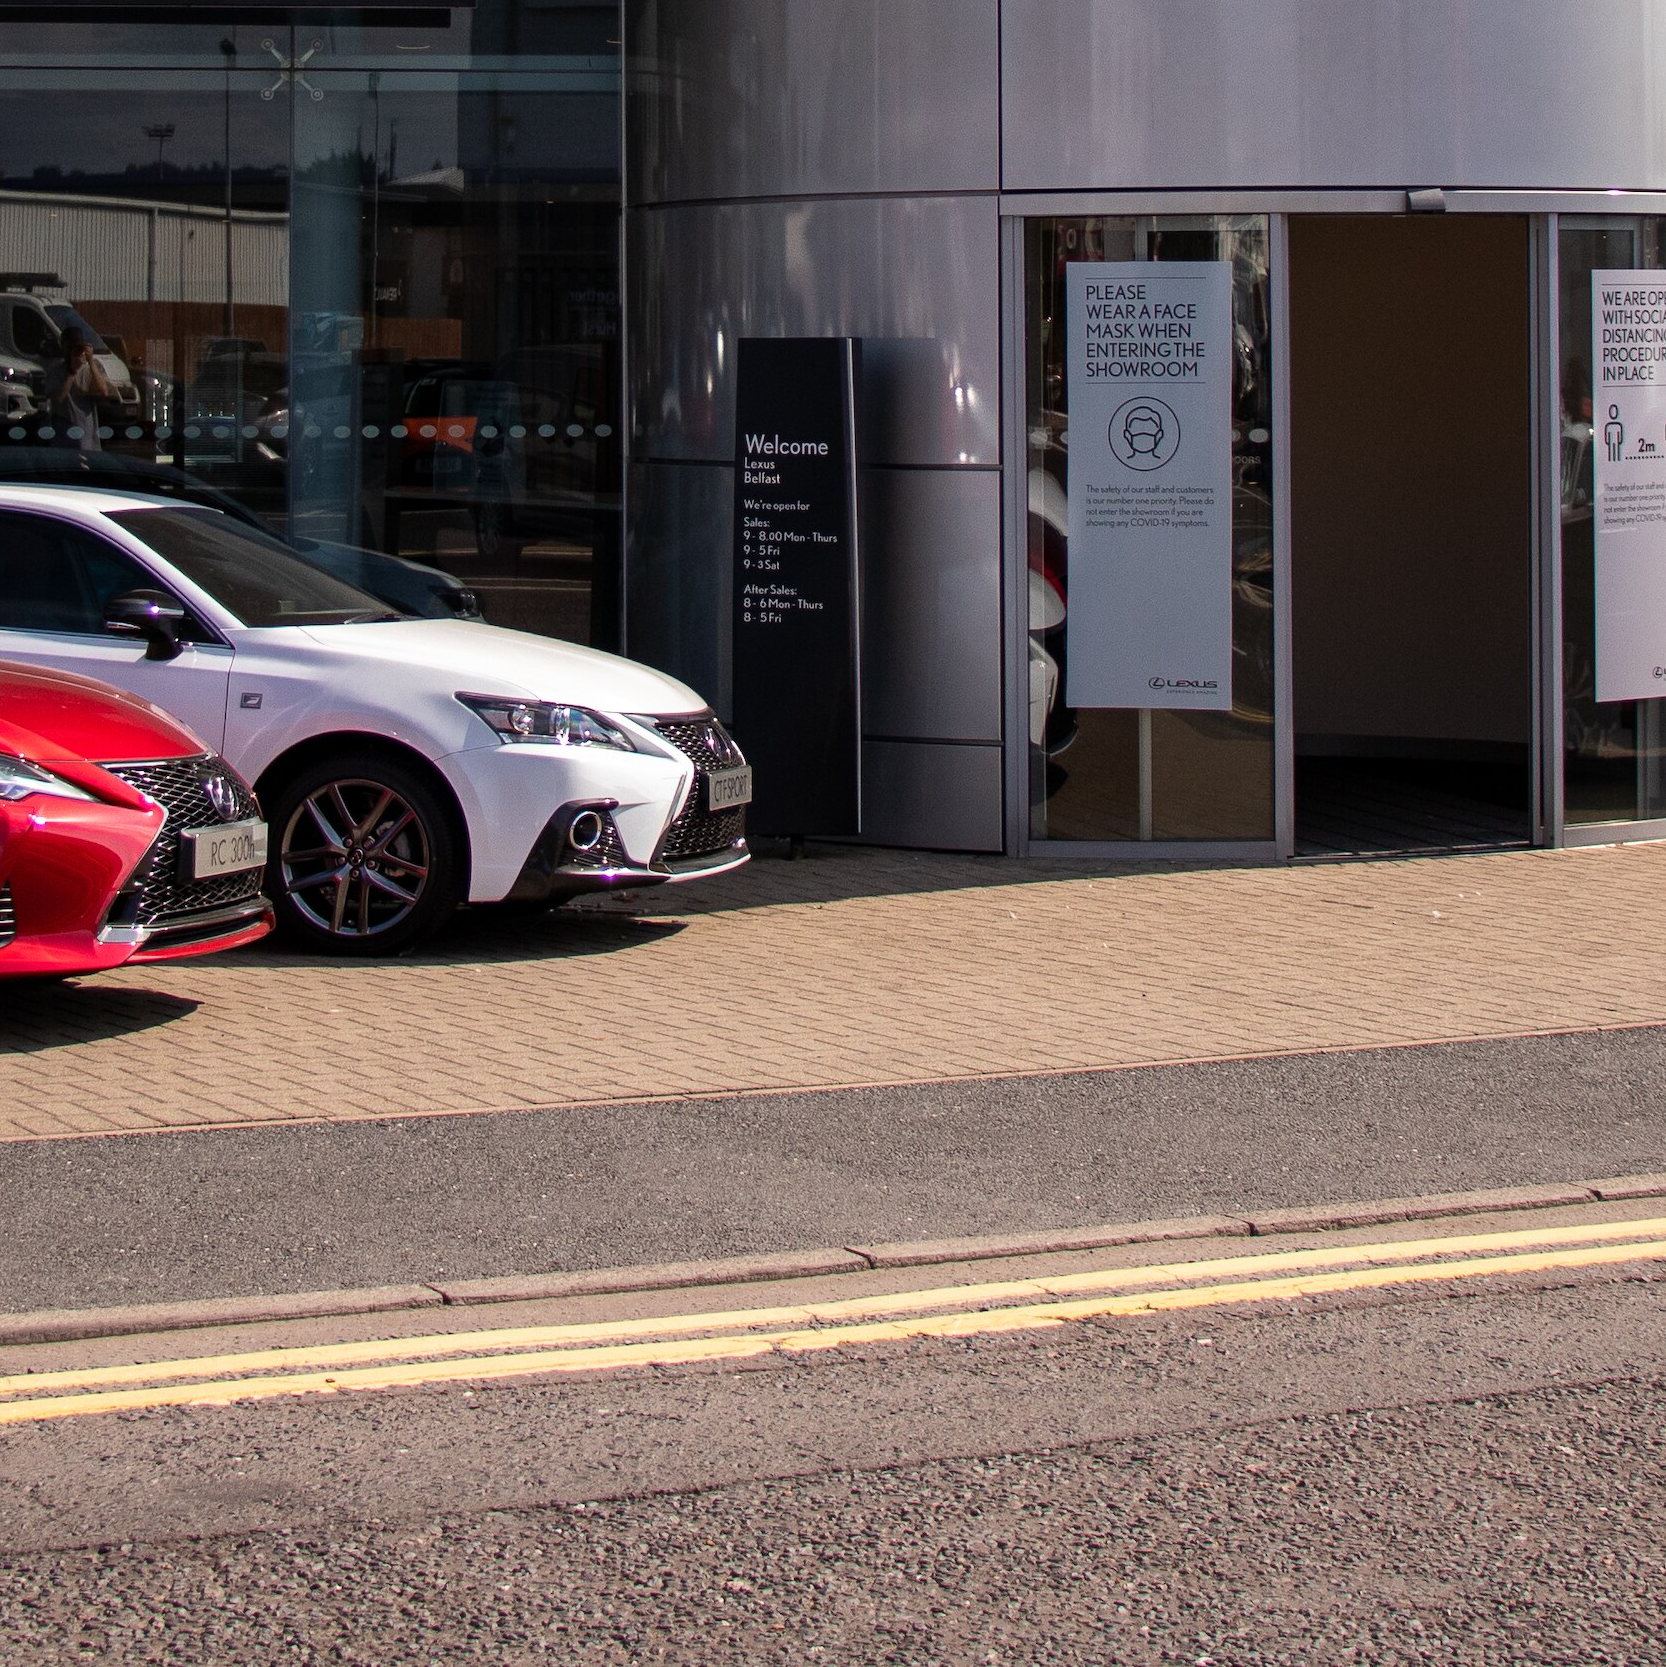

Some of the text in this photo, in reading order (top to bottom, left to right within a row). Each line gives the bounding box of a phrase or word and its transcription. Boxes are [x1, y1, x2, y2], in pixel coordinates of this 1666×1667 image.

[1086, 285, 1146, 300] PLEASE
[1602, 292, 1621, 305] WE
[1624, 292, 1646, 305] ARE
[1086, 304, 1196, 319] WEAR A FACE
[1602, 310, 1632, 324] WITH
[1086, 323, 1191, 338] MASK WHEN
[1087, 342, 1205, 358] ENTERING THE
[1086, 362, 1197, 377] SHOWROOM
[1603, 366, 1654, 381] IN PLACE
[745, 434, 829, 455] Welcome
[1638, 439, 1655, 453] 2m
[744, 457, 775, 469] Lexus
[1234, 455, 1261, 464] OORS
[744, 472, 781, 484] Belfast
[1086, 485, 1099, 493] The
[1101, 485, 1121, 494] safety
[1123, 485, 1130, 493] of
[1145, 485, 1160, 493] staff
[1161, 485, 1175, 493] and
[744, 499, 810, 511] We're open for
[1179, 496, 1203, 505] Please
[1204, 497, 1214, 505] do
[1132, 507, 1170, 515] showroom
[744, 517, 770, 527] Sales:
[1086, 518, 1114, 528] showing
[1116, 520, 1129, 528] any
[1130, 518, 1170, 527] COVID-19
[743, 530, 750, 540] 9
[784, 532, 805, 542] Mon
[812, 532, 837, 542] Thurs
[743, 545, 750, 555] 9
[759, 545, 766, 555] 5
[767, 546, 780, 555] Fri
[743, 559, 750, 569] 9
[757, 560, 764, 569] 3
[765, 560, 780, 570] Sat
[743, 584, 797, 595] After Sales:
[743, 598, 751, 608] 8
[760, 598, 767, 608] 6
[768, 598, 790, 608] Mon
[797, 599, 823, 609] Thurs
[743, 612, 751, 622] 8
[760, 612, 767, 622] 5
[769, 613, 782, 623] Fri
[1167, 680, 1218, 688] LEXUS
[727, 774, 747, 799] SPORT
[211, 835, 255, 867] RC 300h
